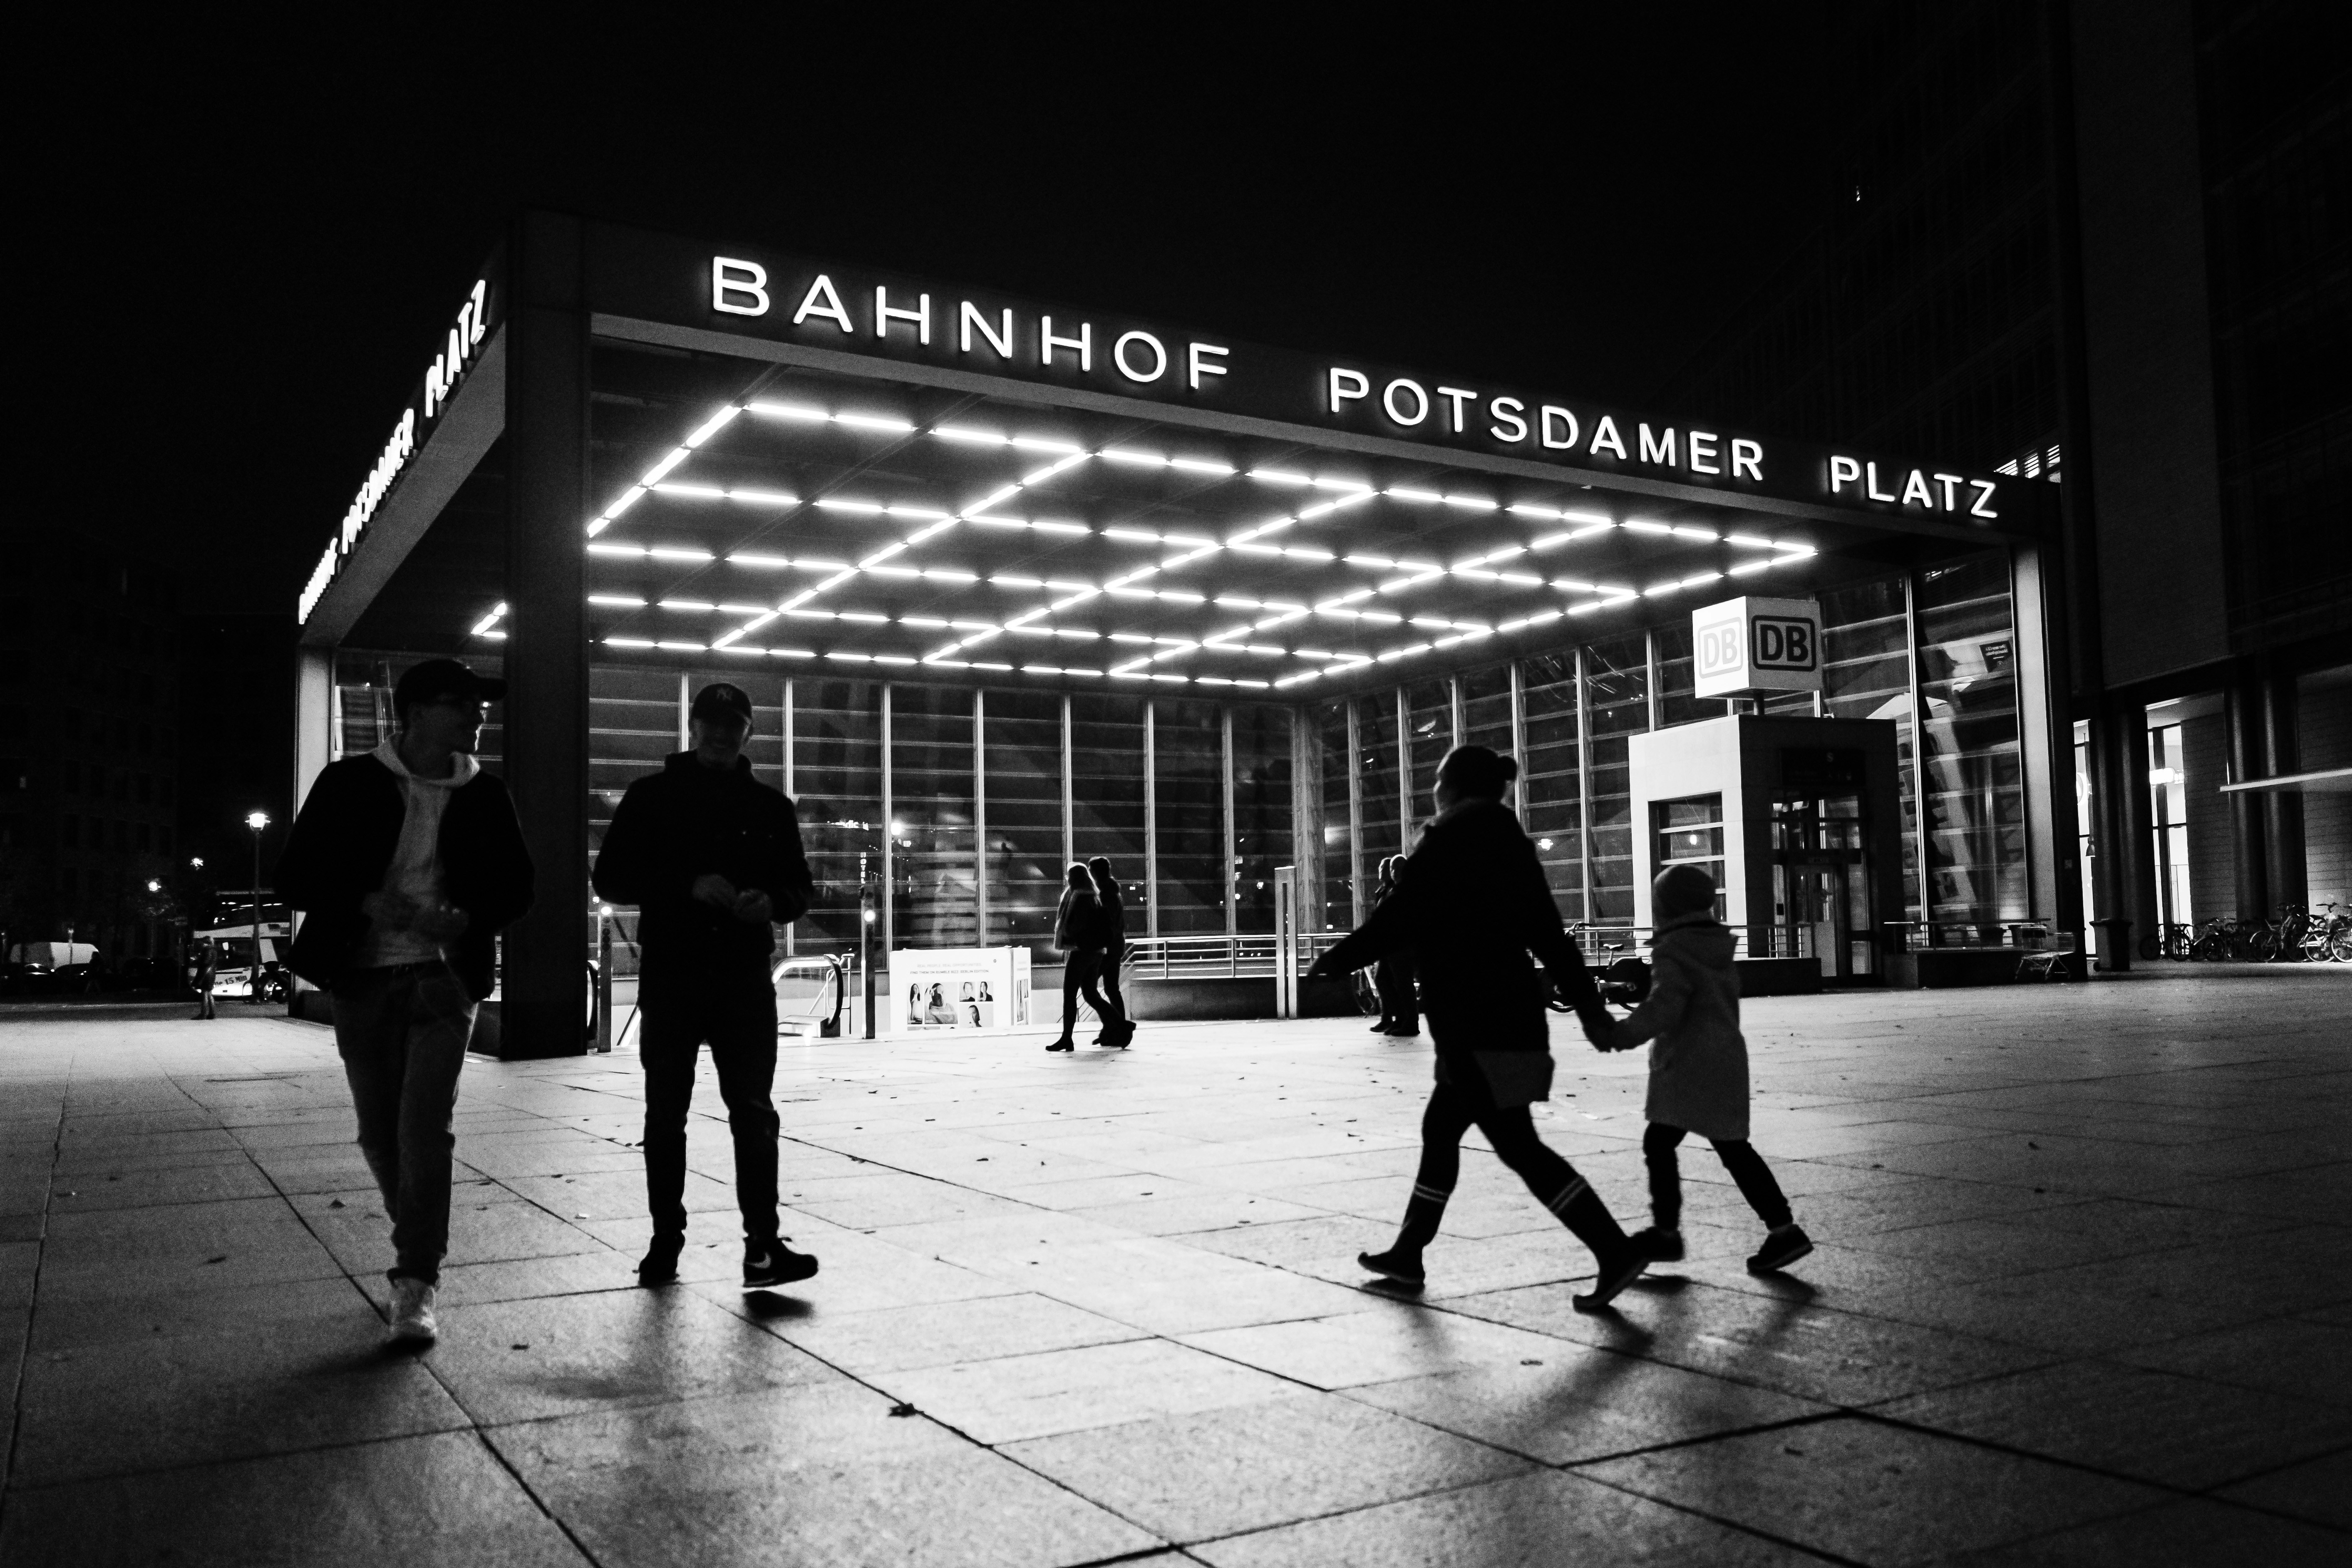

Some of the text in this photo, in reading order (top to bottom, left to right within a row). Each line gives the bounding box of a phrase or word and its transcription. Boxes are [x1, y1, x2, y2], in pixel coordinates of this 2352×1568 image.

[712, 256, 1999, 519] BAHNHOF POTSDAMER PLATZ
[1704, 628, 1737, 669] DB
[1760, 624, 1809, 662] DB
[716, 687, 733, 701] NY
